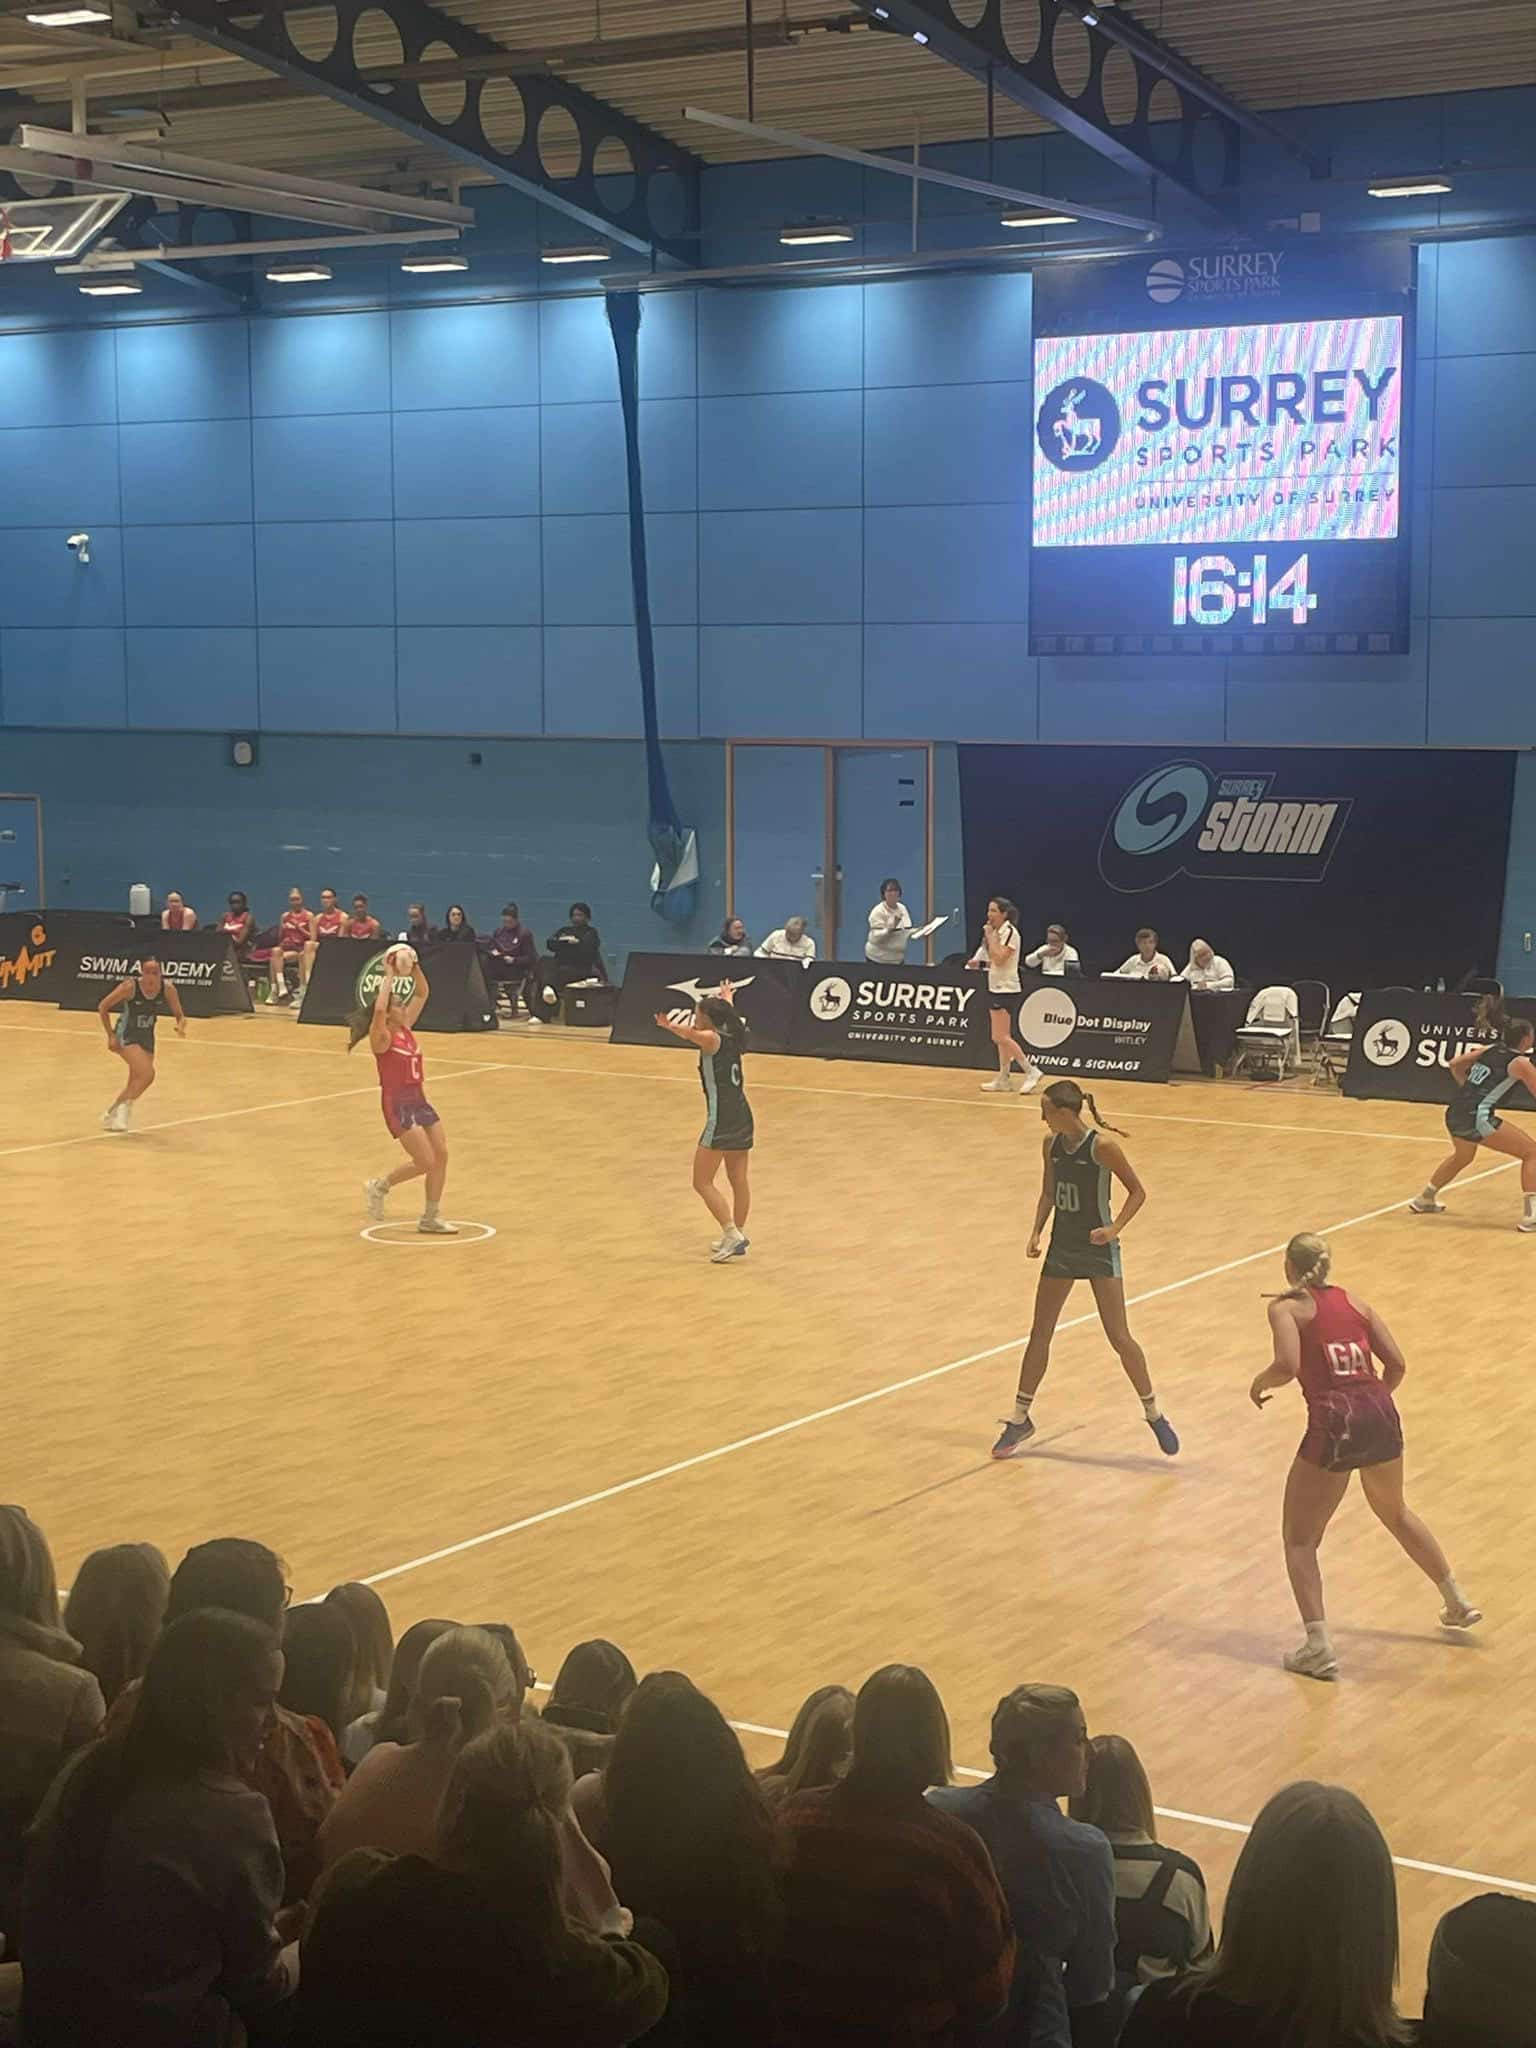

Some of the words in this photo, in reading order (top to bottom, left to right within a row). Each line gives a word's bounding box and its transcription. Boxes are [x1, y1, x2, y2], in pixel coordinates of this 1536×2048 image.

[1189, 251, 1284, 280] SURREY
[1187, 278, 1241, 293] SPORTS
[1244, 275, 1281, 295] PARK
[1137, 367, 1396, 432] SURREY
[1137, 442, 1274, 466] SPORTS
[1300, 437, 1396, 459] PARK
[1135, 492, 1260, 509] UNIVERSITY
[1272, 490, 1298, 505] OF
[1308, 487, 1395, 504] SURREY
[1173, 553, 1318, 625] 16:14
[80, 956, 129, 973] SWIM
[129, 960, 216, 978] ADEMY
[362, 974, 413, 995] SPRTS
[856, 981, 976, 1012] SURREY
[853, 1010, 916, 1024] SPORTS
[926, 1014, 969, 1029] PARK
[1043, 1012, 1073, 1026] Blue
[1076, 1015, 1100, 1028] Dot
[1102, 1017, 1152, 1033] Display
[848, 1031, 906, 1042] UNIVERSITY
[909, 1035, 924, 1044] OF
[926, 1038, 965, 1047] SURREY
[410, 1056, 421, 1080] C
[1071, 1058, 1082, 1068] &
[1327, 1342, 1369, 1376] GA
